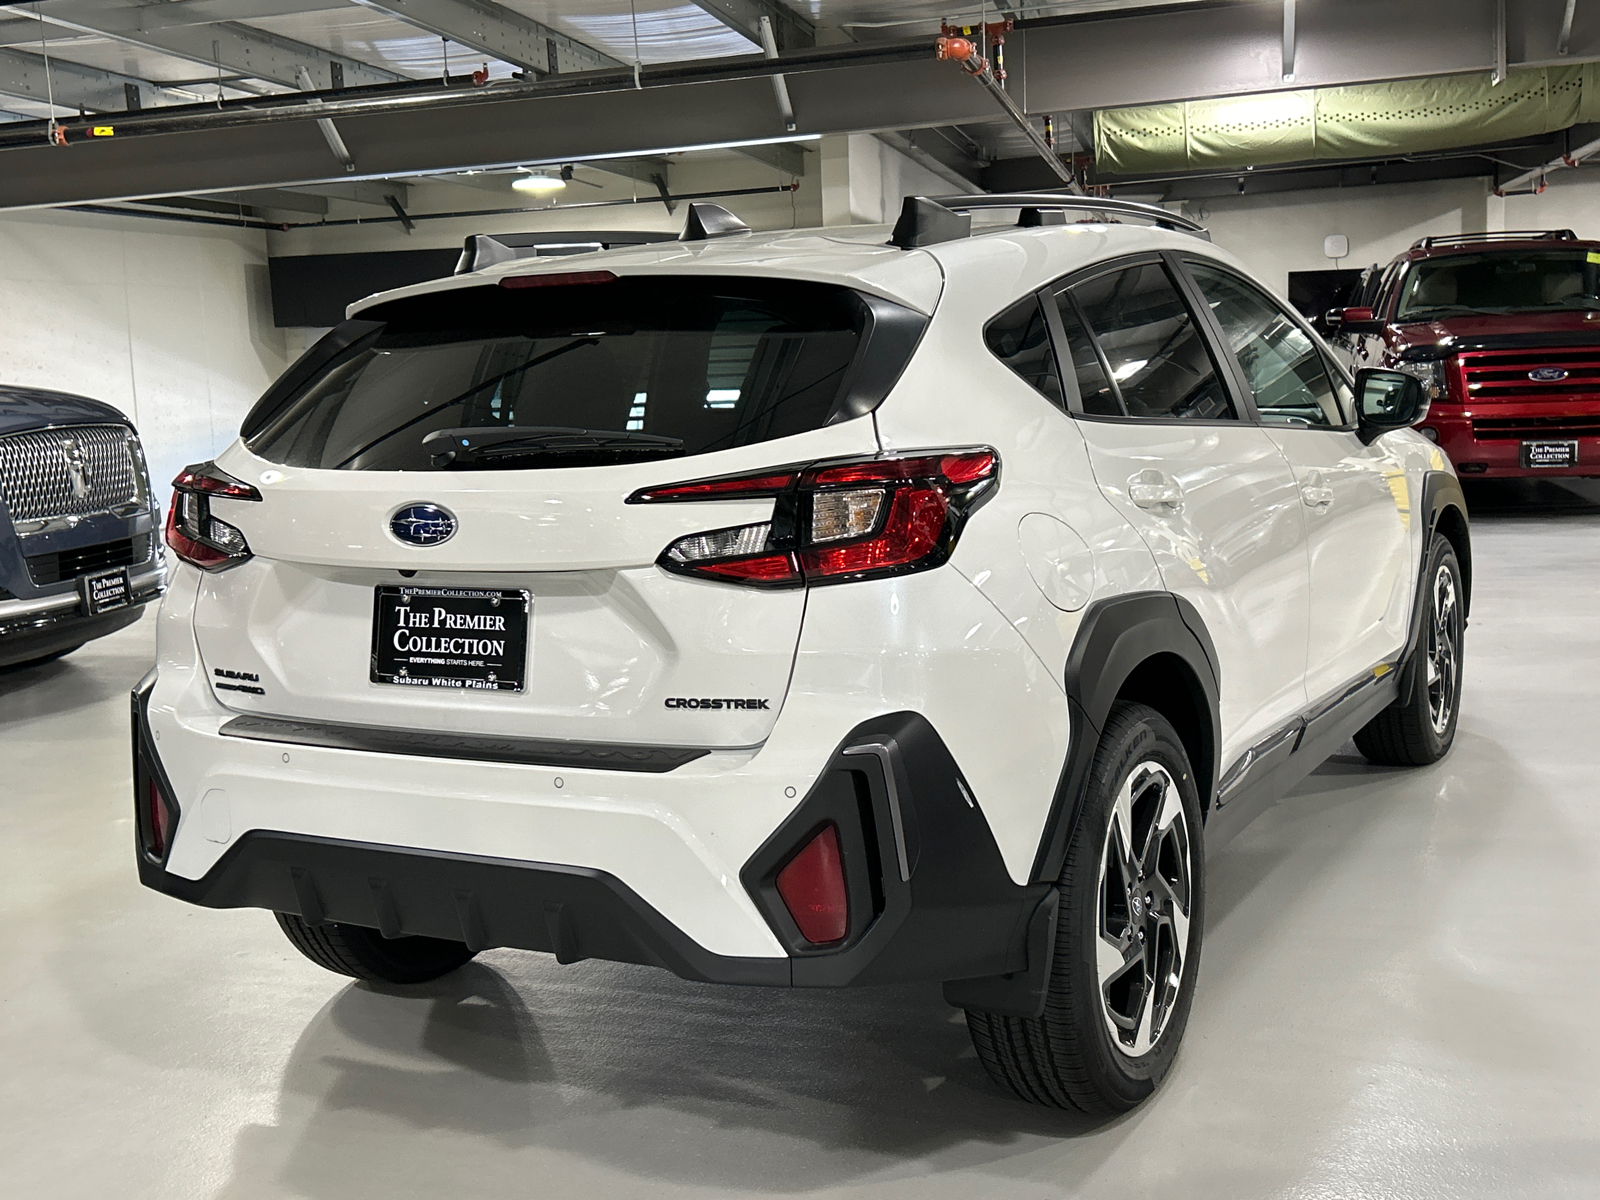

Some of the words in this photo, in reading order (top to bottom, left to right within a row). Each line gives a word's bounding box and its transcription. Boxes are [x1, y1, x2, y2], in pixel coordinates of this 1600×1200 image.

[395, 606, 430, 628] THE
[433, 607, 506, 631] PREMIER
[393, 629, 505, 656] COLLECTION
[409, 657, 445, 665] EVERYTHING
[214, 668, 259, 681] SUBARU
[393, 676, 429, 686] Subaru
[432, 677, 462, 687] White
[465, 680, 498, 690] Plains
[664, 698, 770, 710] CROSSTREK
